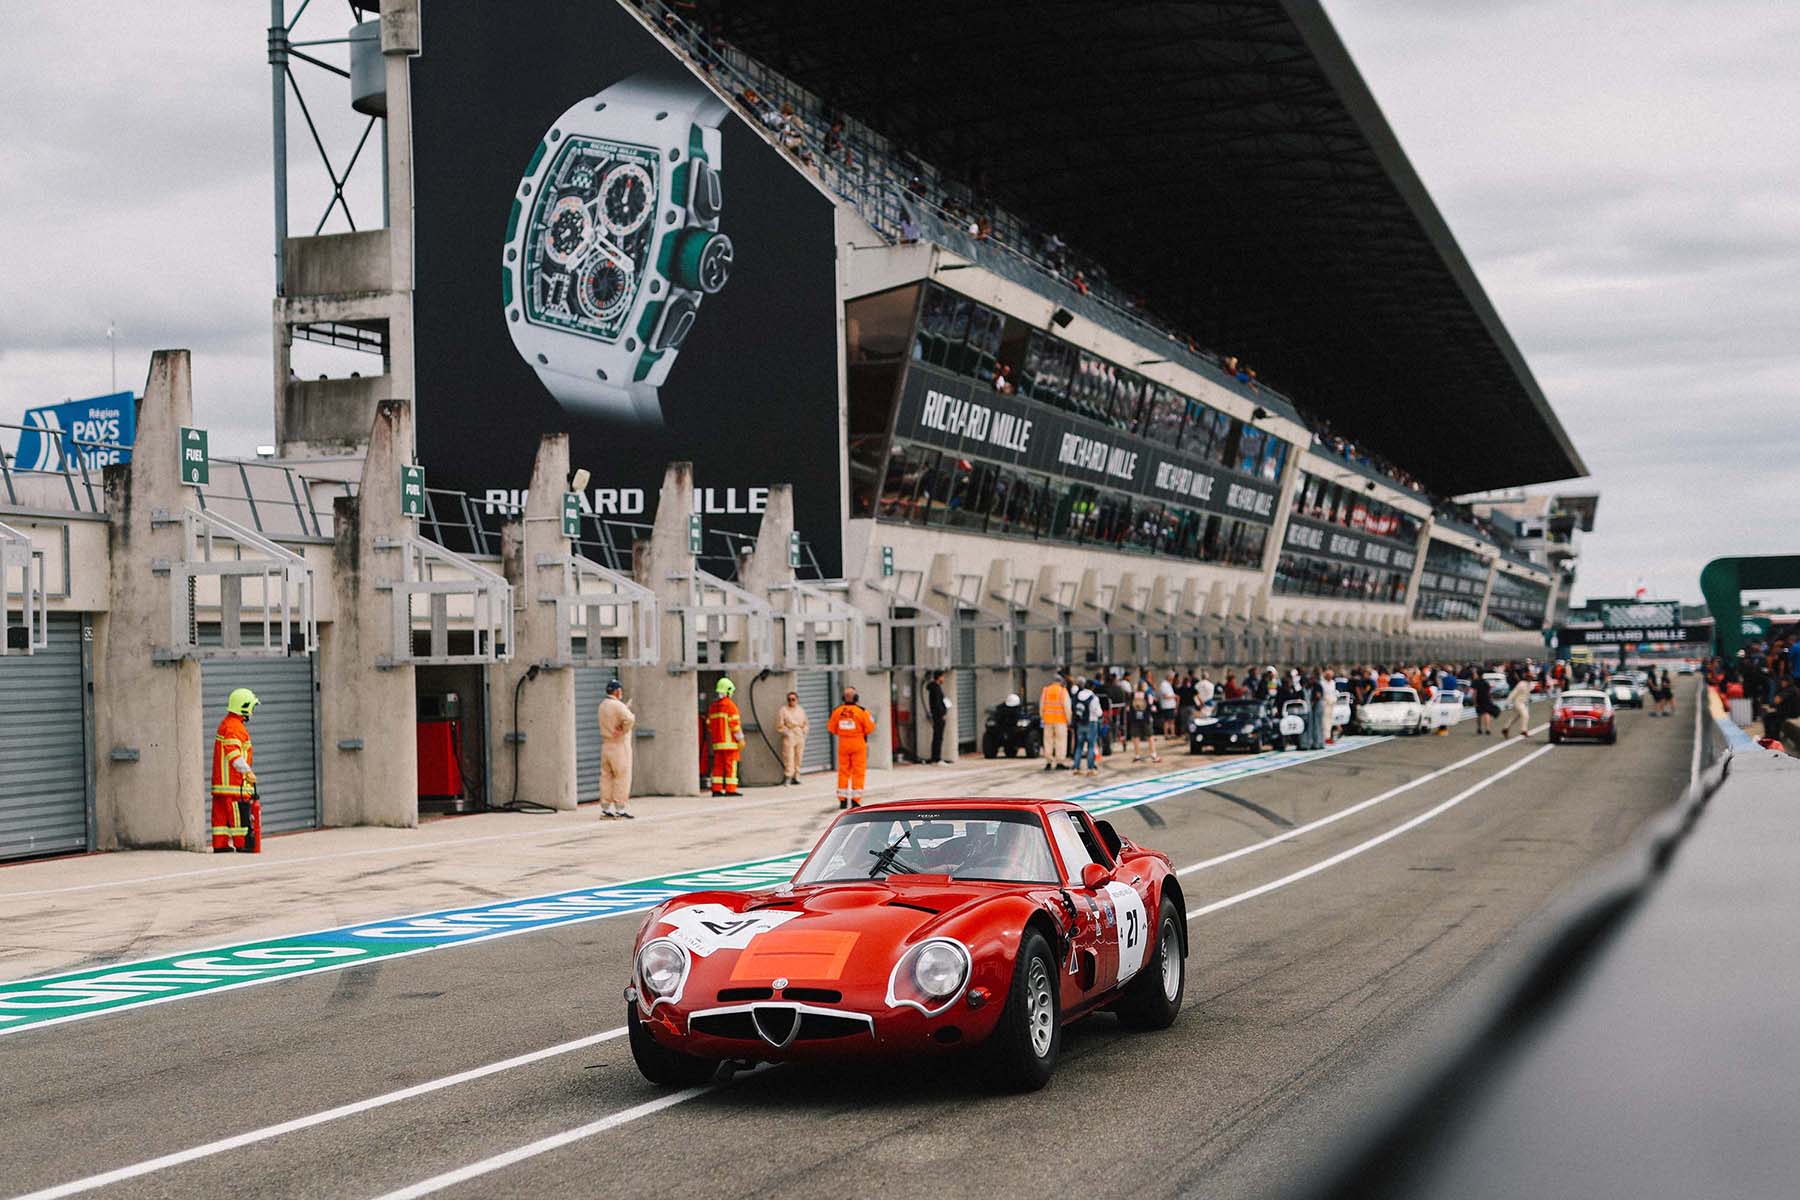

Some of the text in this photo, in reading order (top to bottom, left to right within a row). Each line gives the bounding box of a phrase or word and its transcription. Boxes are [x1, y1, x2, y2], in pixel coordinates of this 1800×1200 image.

[89, 408, 120, 420] Région
[921, 390, 1032, 453] RICHARD MILLE
[73, 420, 120, 442] PAYS
[186, 448, 203, 462] FUEL
[1059, 432, 1138, 480] RICHARD MILLE
[406, 483, 421, 496] FUEL
[485, 488, 769, 514] RIARD ILLE
[1126, 909, 1138, 949] 21
[0, 946, 368, 1022] amco
